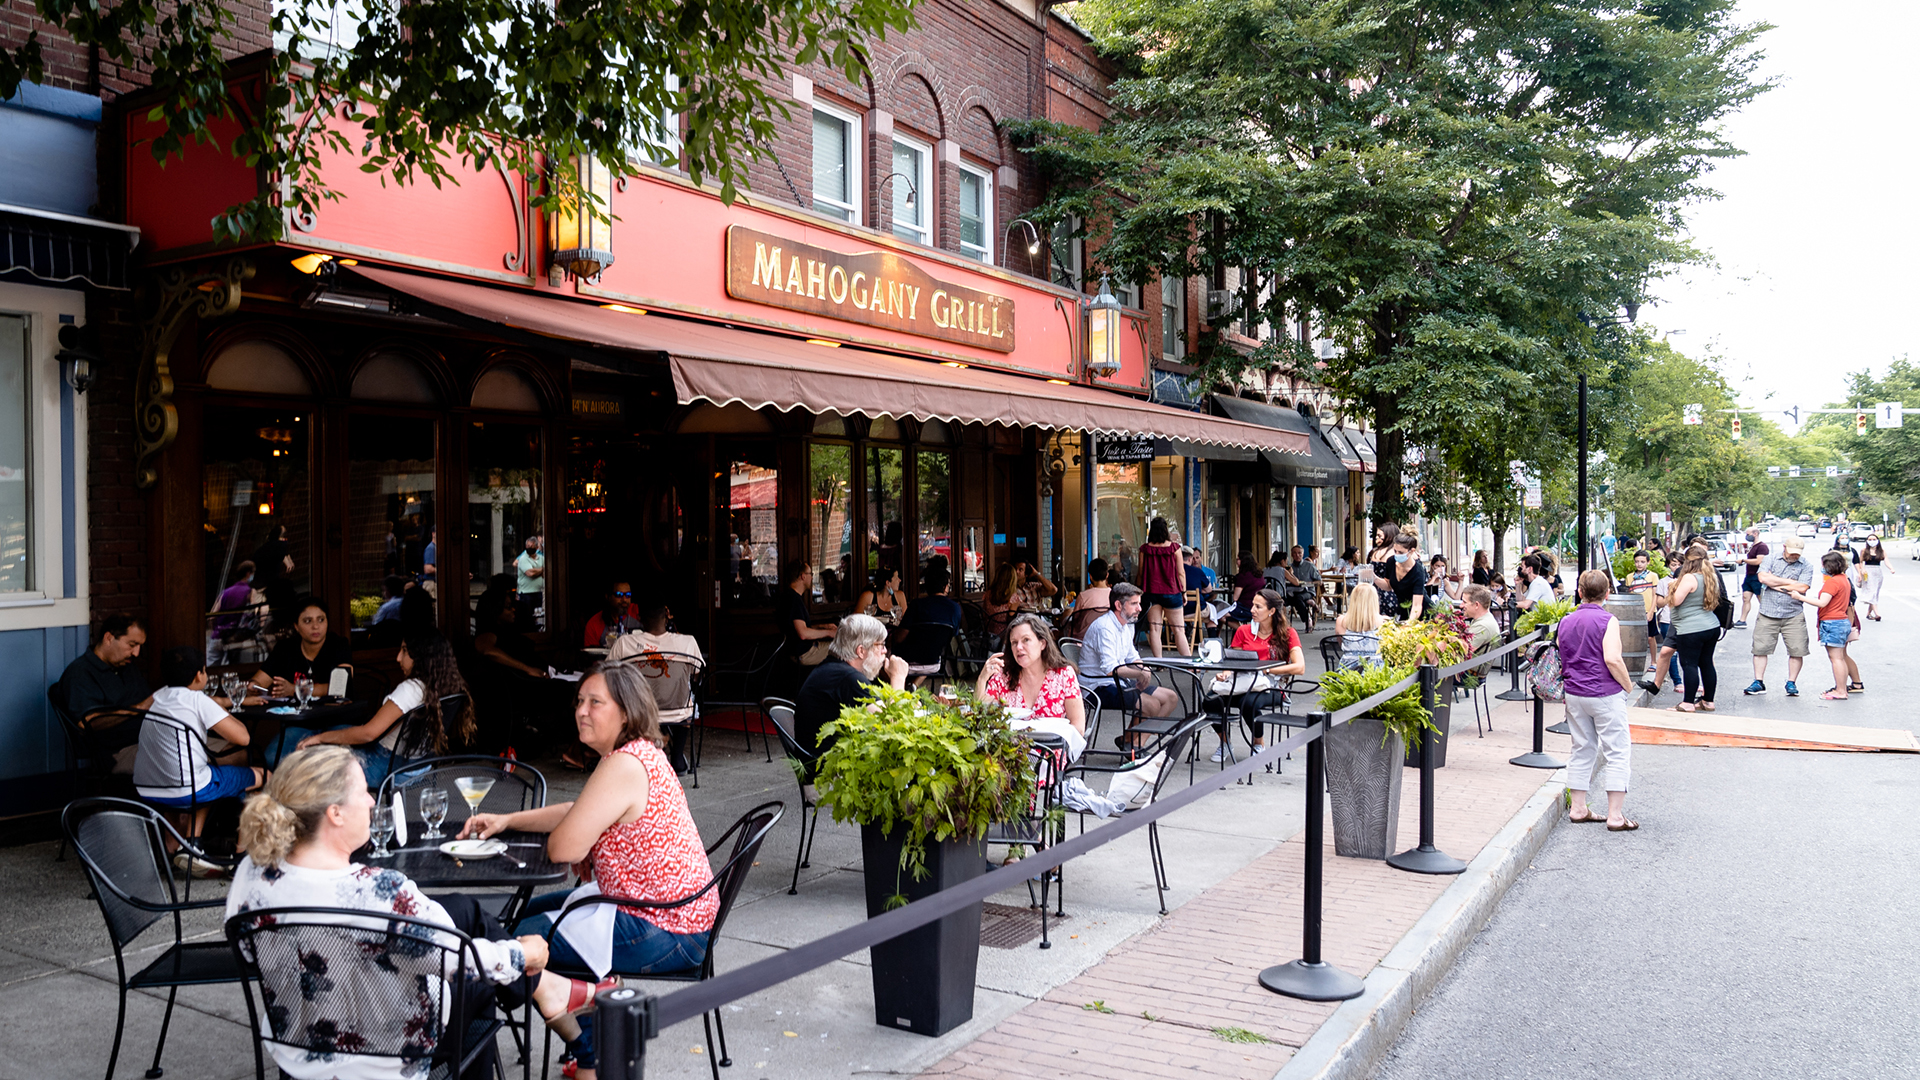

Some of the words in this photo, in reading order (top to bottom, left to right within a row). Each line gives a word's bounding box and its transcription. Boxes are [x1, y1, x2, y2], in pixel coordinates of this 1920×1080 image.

[751, 241, 921, 321] MAHOGANY
[930, 288, 1004, 339] GRILL
[590, 400, 620, 414] AURORA
[1098, 443, 1120, 458] Just
[1128, 441, 1154, 455] Taste
